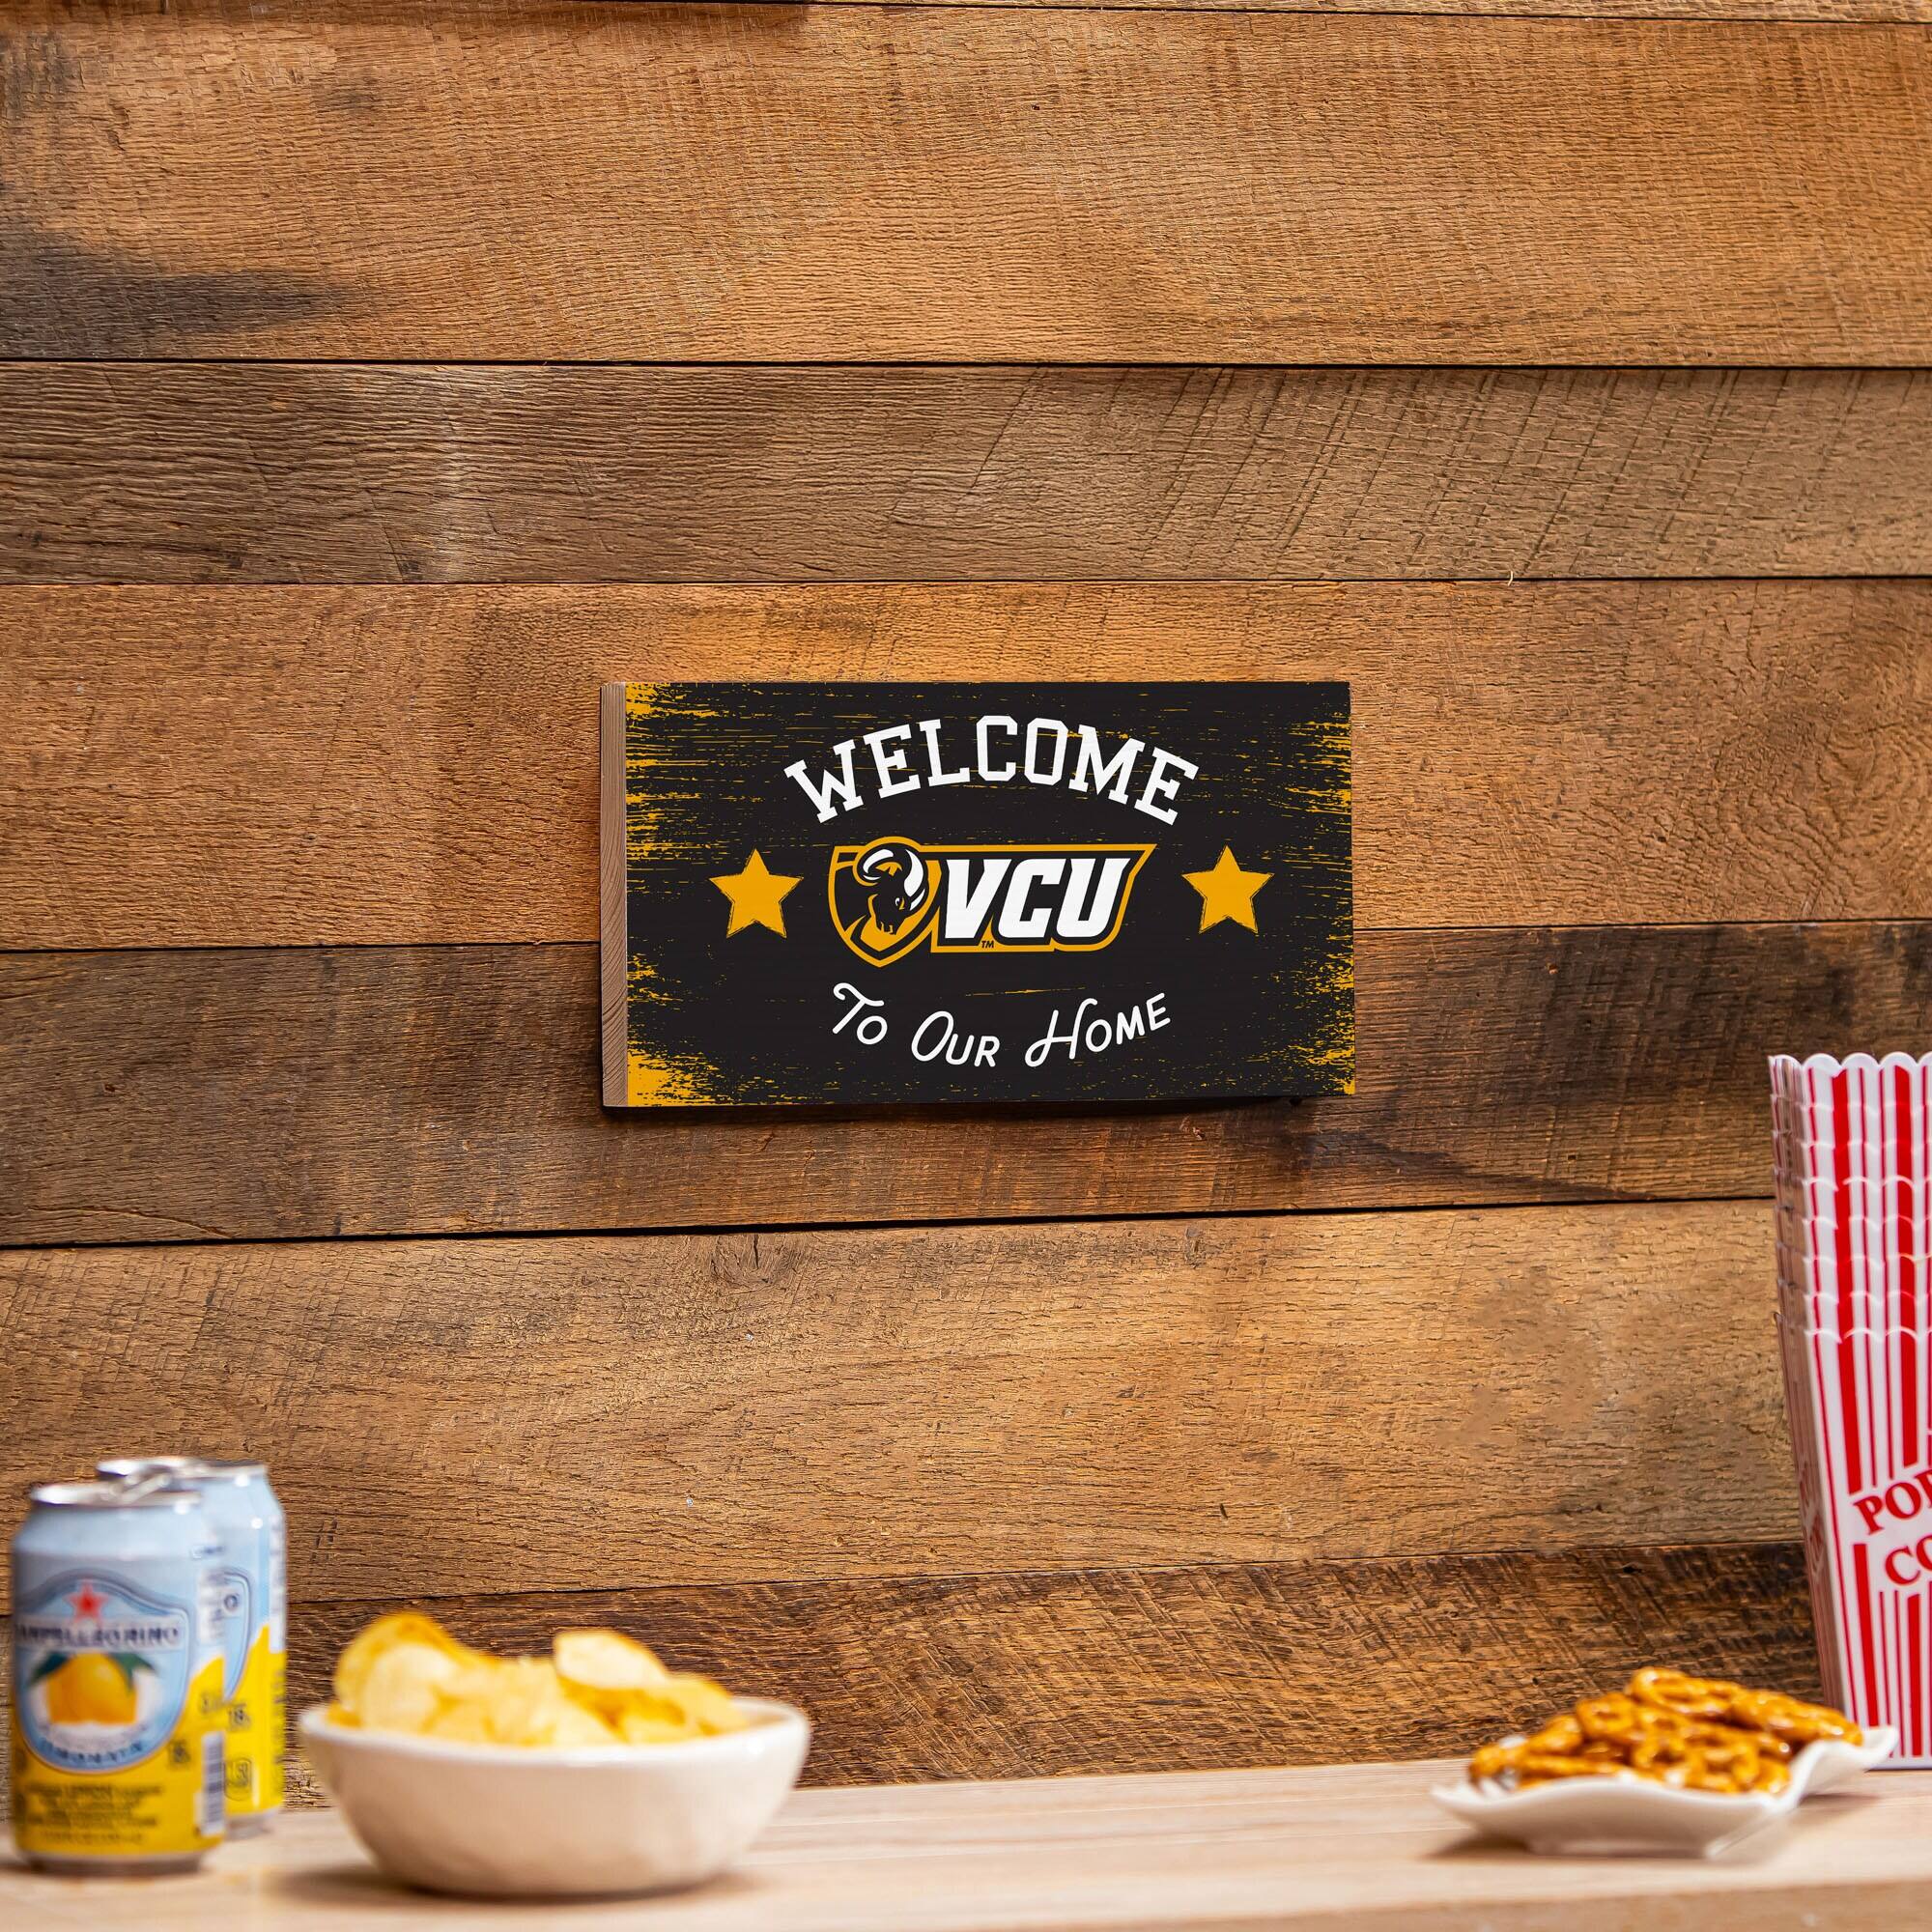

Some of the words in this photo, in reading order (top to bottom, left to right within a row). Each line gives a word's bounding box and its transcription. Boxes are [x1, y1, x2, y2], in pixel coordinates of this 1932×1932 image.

[783, 715, 1200, 826] WELCOME
[944, 858, 1131, 939] VCU
[981, 940, 995, 949] TM
[832, 982, 888, 1046] TO
[911, 1010, 1001, 1067] OUR
[1024, 992, 1171, 1067] HOME
